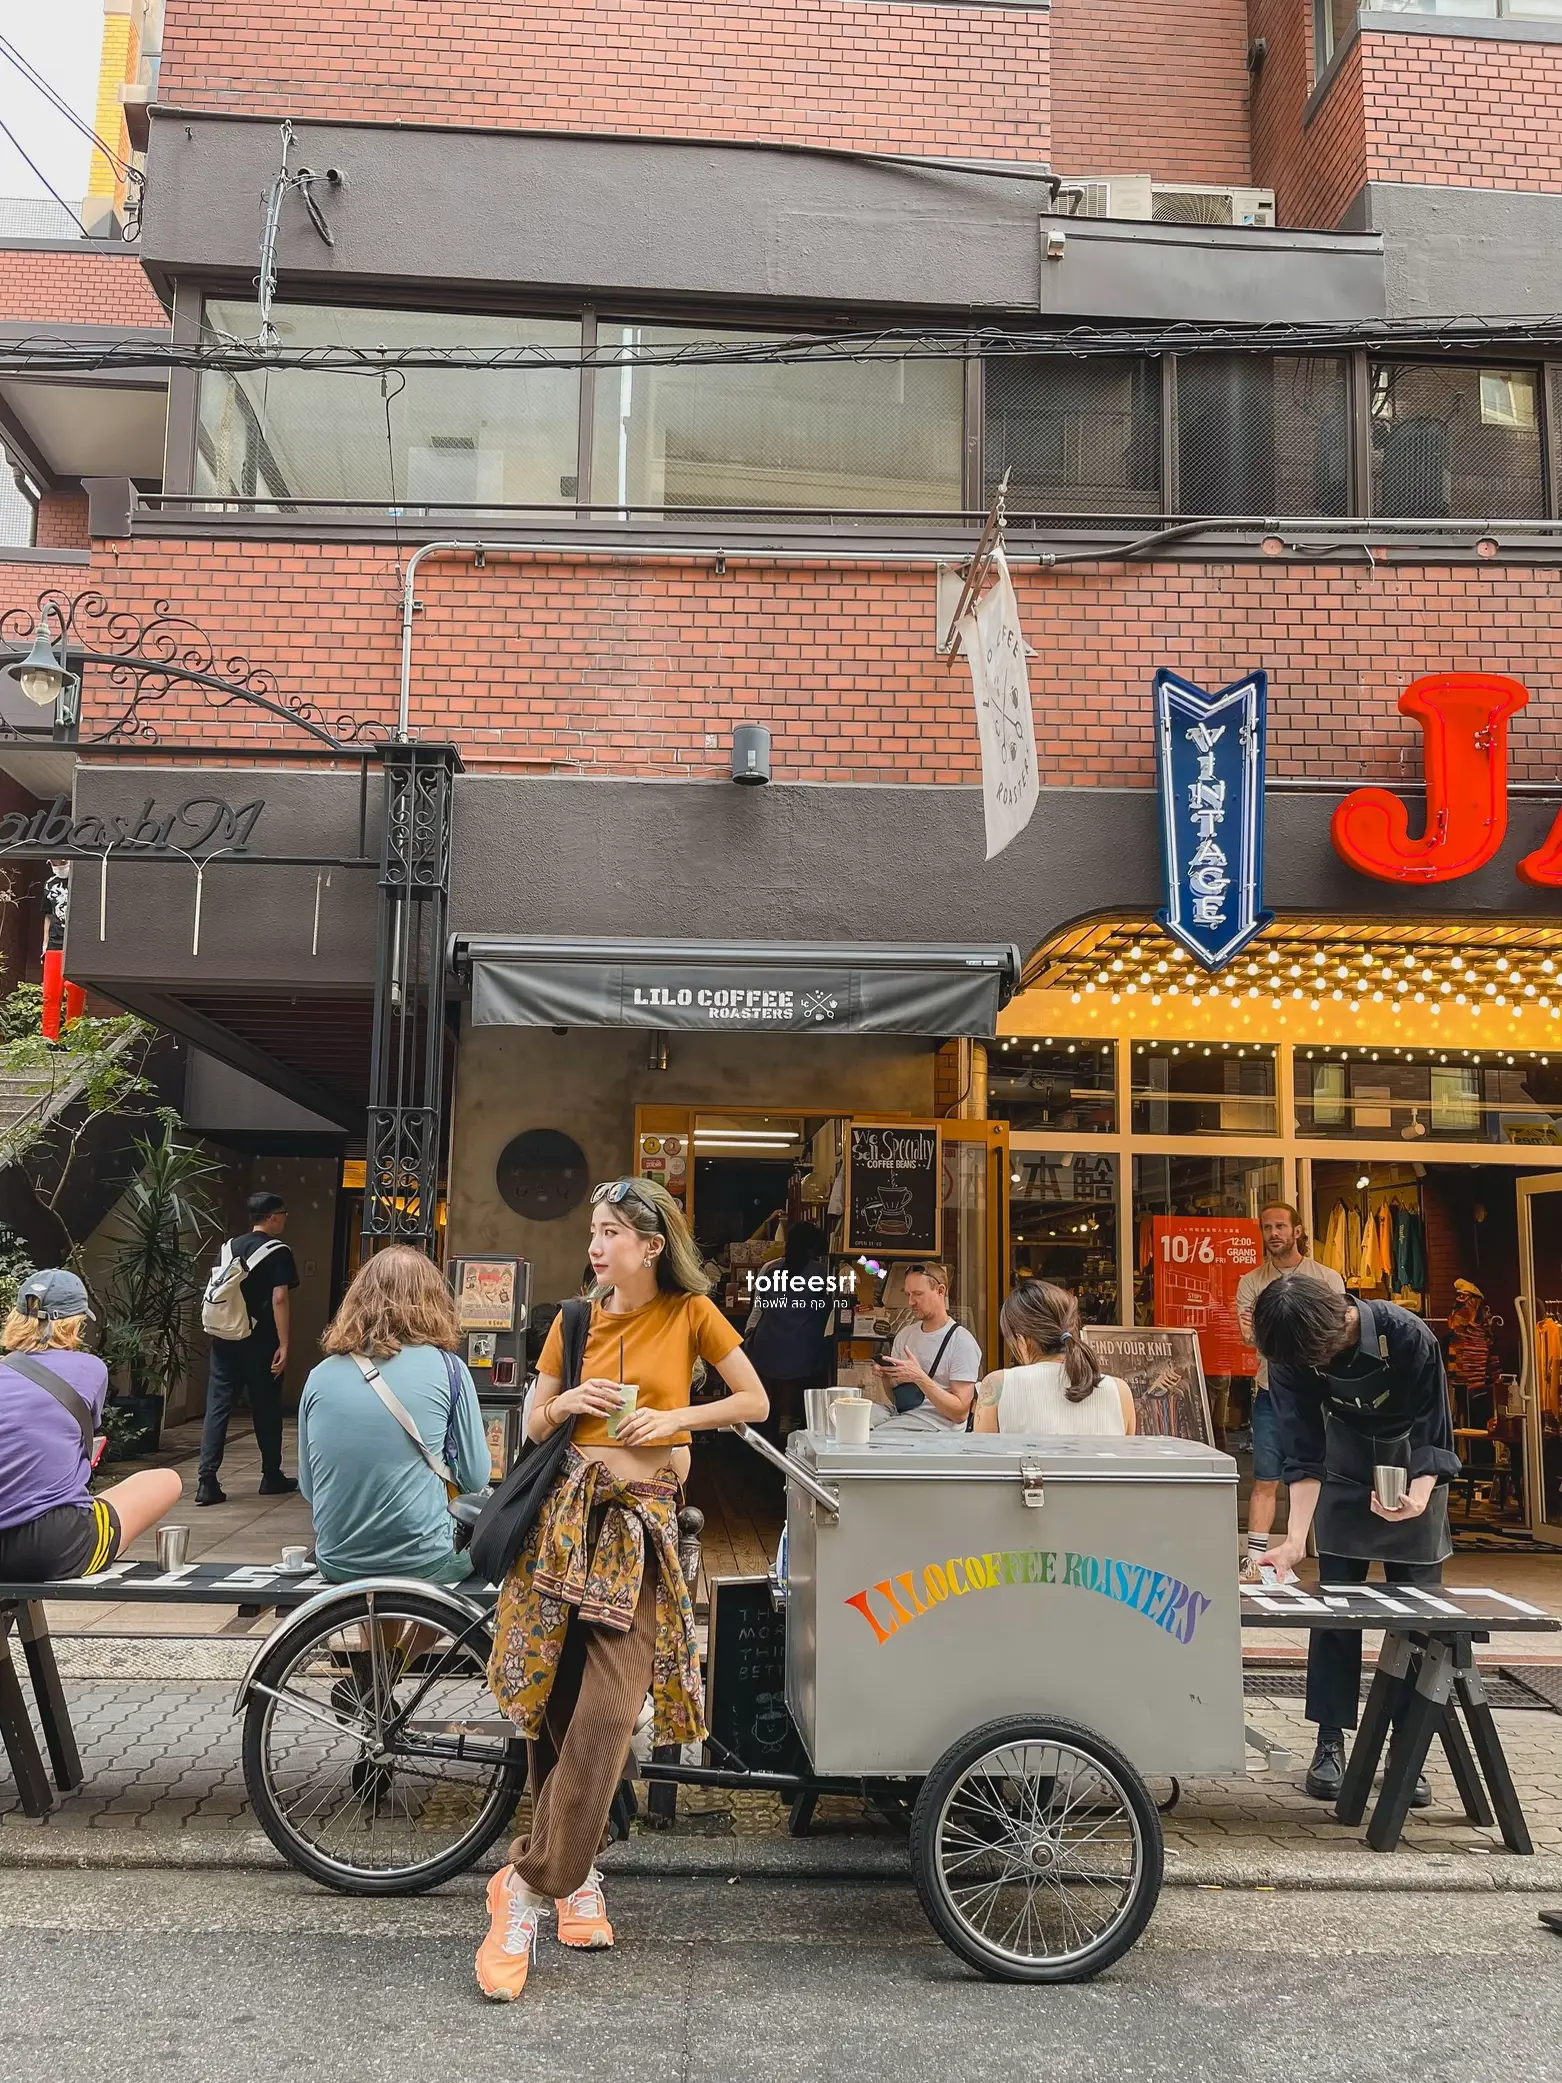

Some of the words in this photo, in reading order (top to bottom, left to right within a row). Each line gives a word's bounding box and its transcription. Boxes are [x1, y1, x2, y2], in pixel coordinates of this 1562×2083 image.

[1186, 722, 1231, 930] VINTAGE
[633, 988, 693, 1006] LILO
[697, 989, 794, 1007] COFFEE
[708, 1007, 794, 1020] ROASTERS
[852, 1130, 879, 1145] We
[852, 1143, 879, 1161] Sell
[880, 1130, 935, 1170] Specialty
[866, 1160, 895, 1169] COFFEE
[895, 1160, 917, 1169] BEANS
[1160, 1235, 1215, 1264] 10/6
[1226, 1248, 1257, 1257] GRAND
[1232, 1256, 1257, 1265] OPEN
[1090, 1340, 1115, 1355] FIND
[1116, 1341, 1146, 1356] YOUR
[1147, 1342, 1173, 1357] KNIT
[1062, 1552, 1213, 1645] ROASTERS
